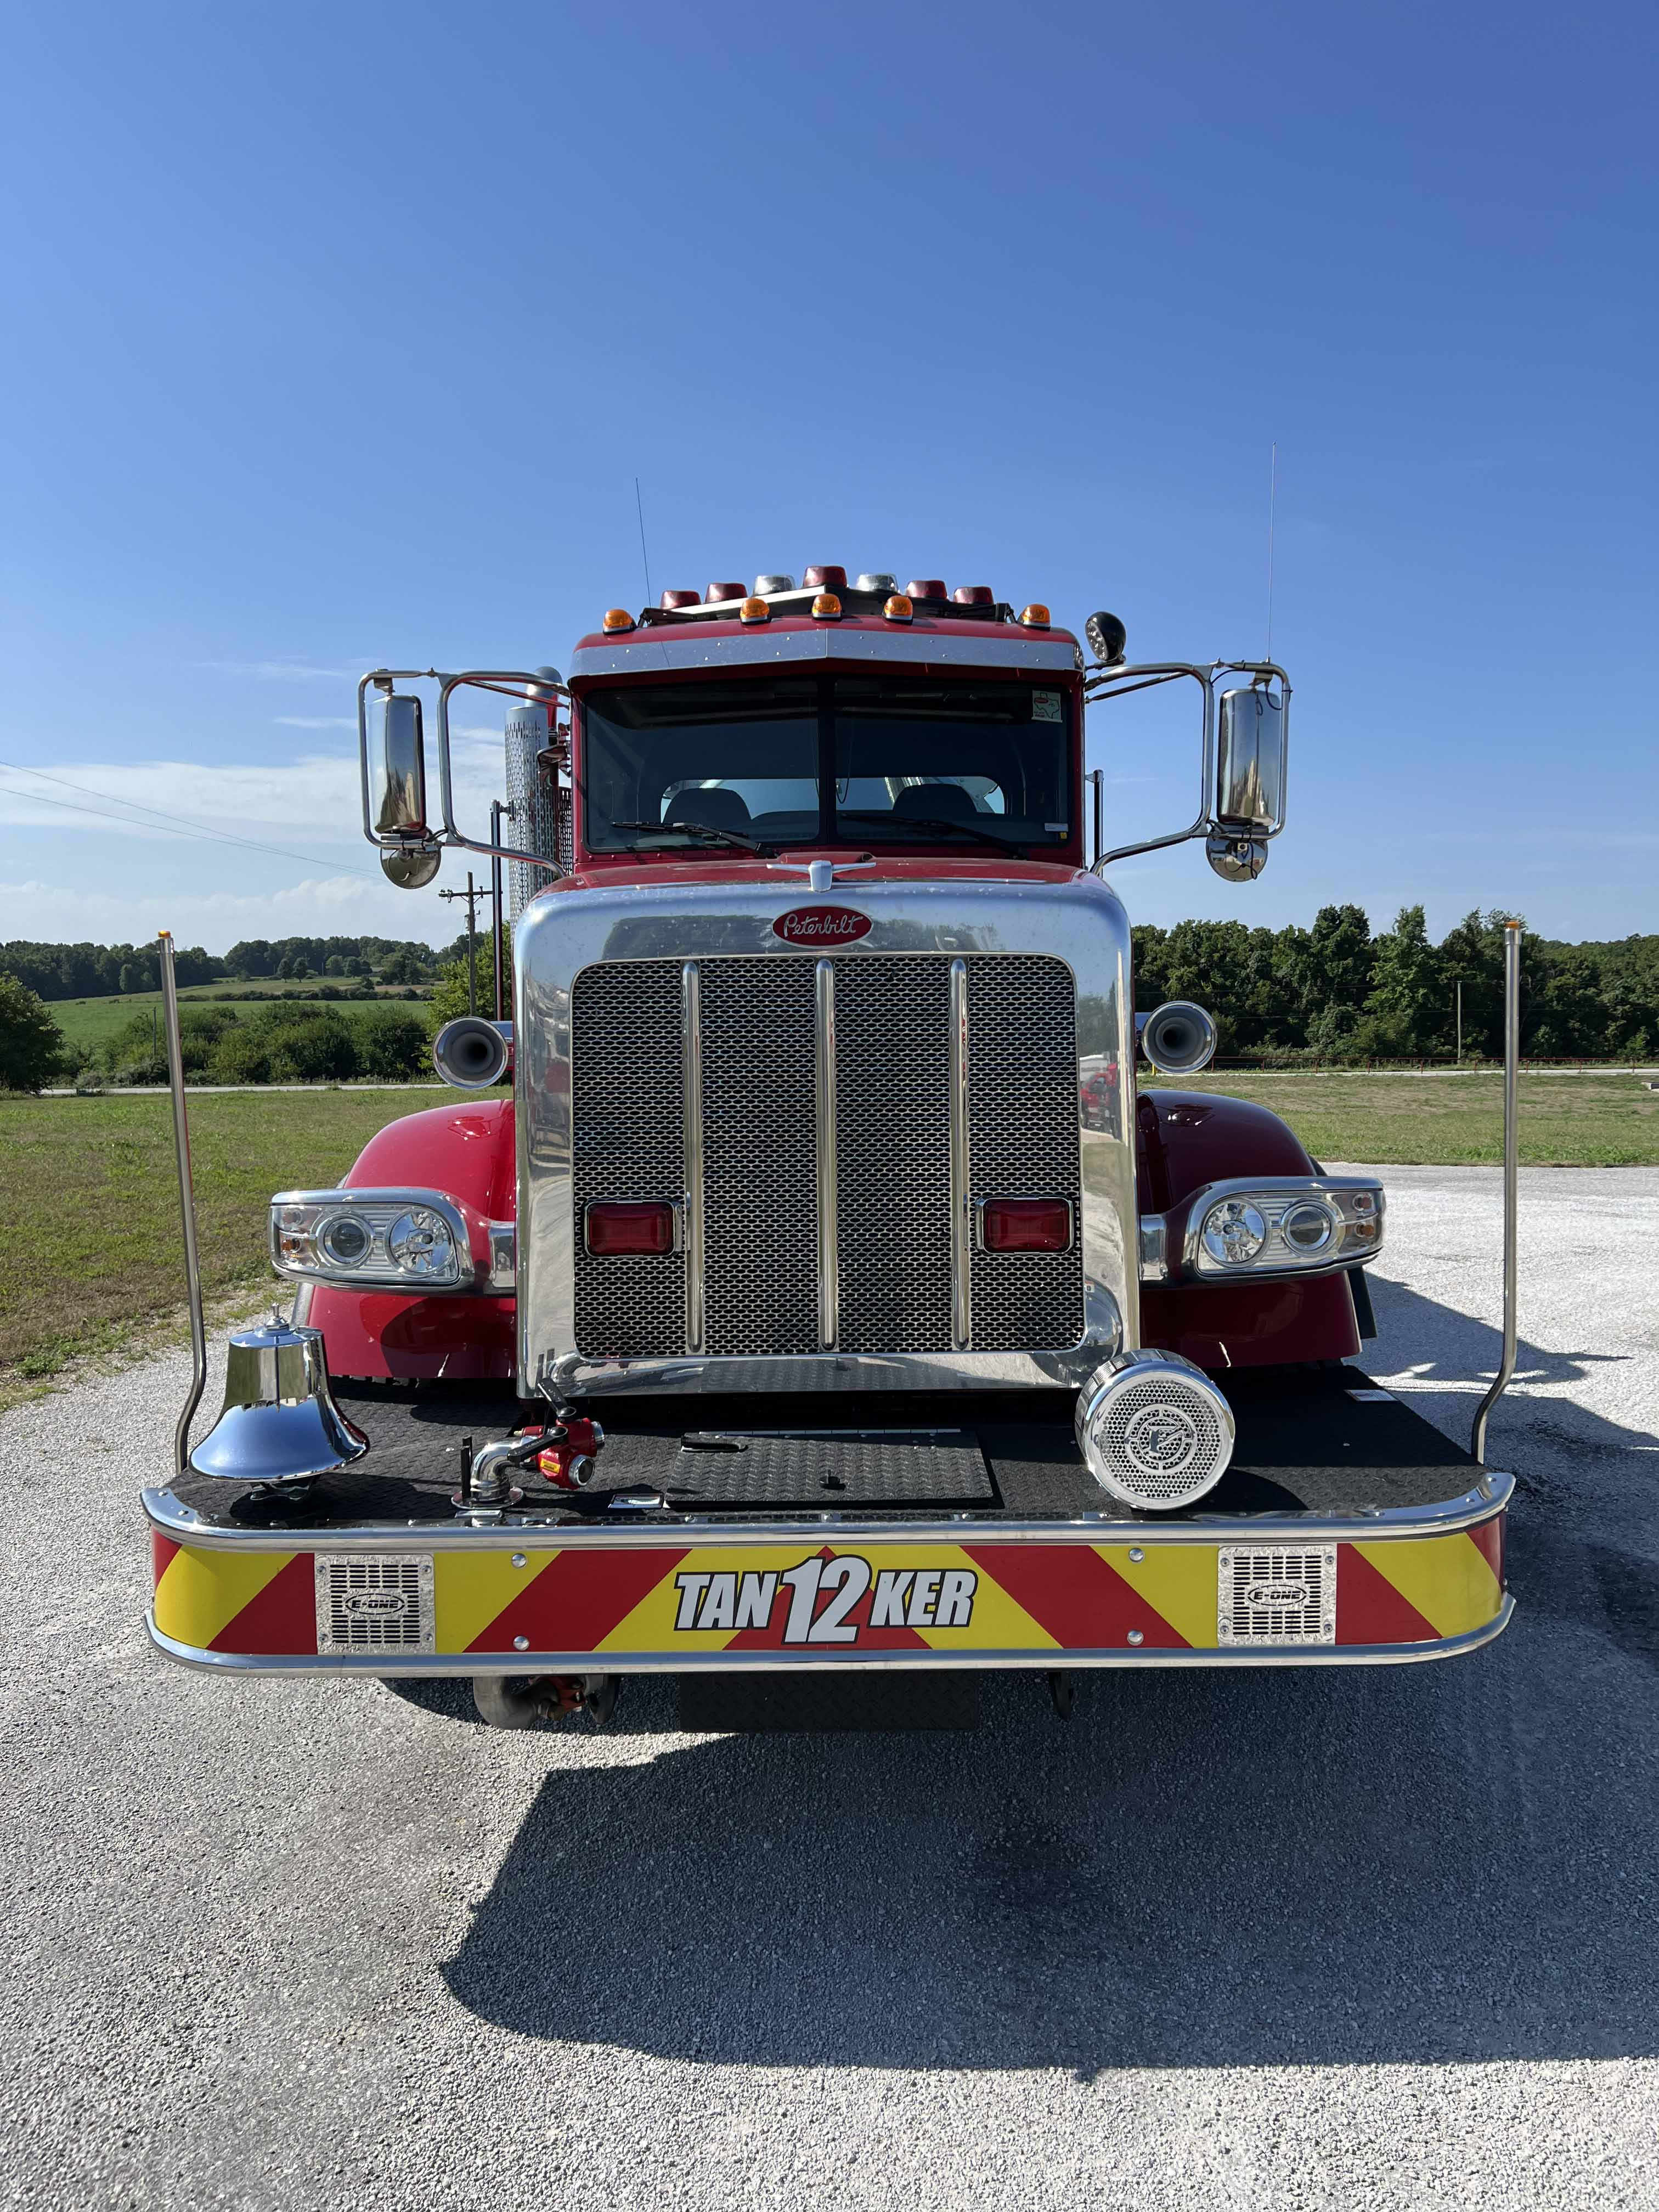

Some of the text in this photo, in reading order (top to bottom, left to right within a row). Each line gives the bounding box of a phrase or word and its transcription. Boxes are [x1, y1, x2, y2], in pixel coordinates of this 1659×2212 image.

[783, 913, 864, 938] Peterbilt
[1253, 1590, 1301, 1600] E-ONE
[351, 1600, 399, 1609] E-ONE
